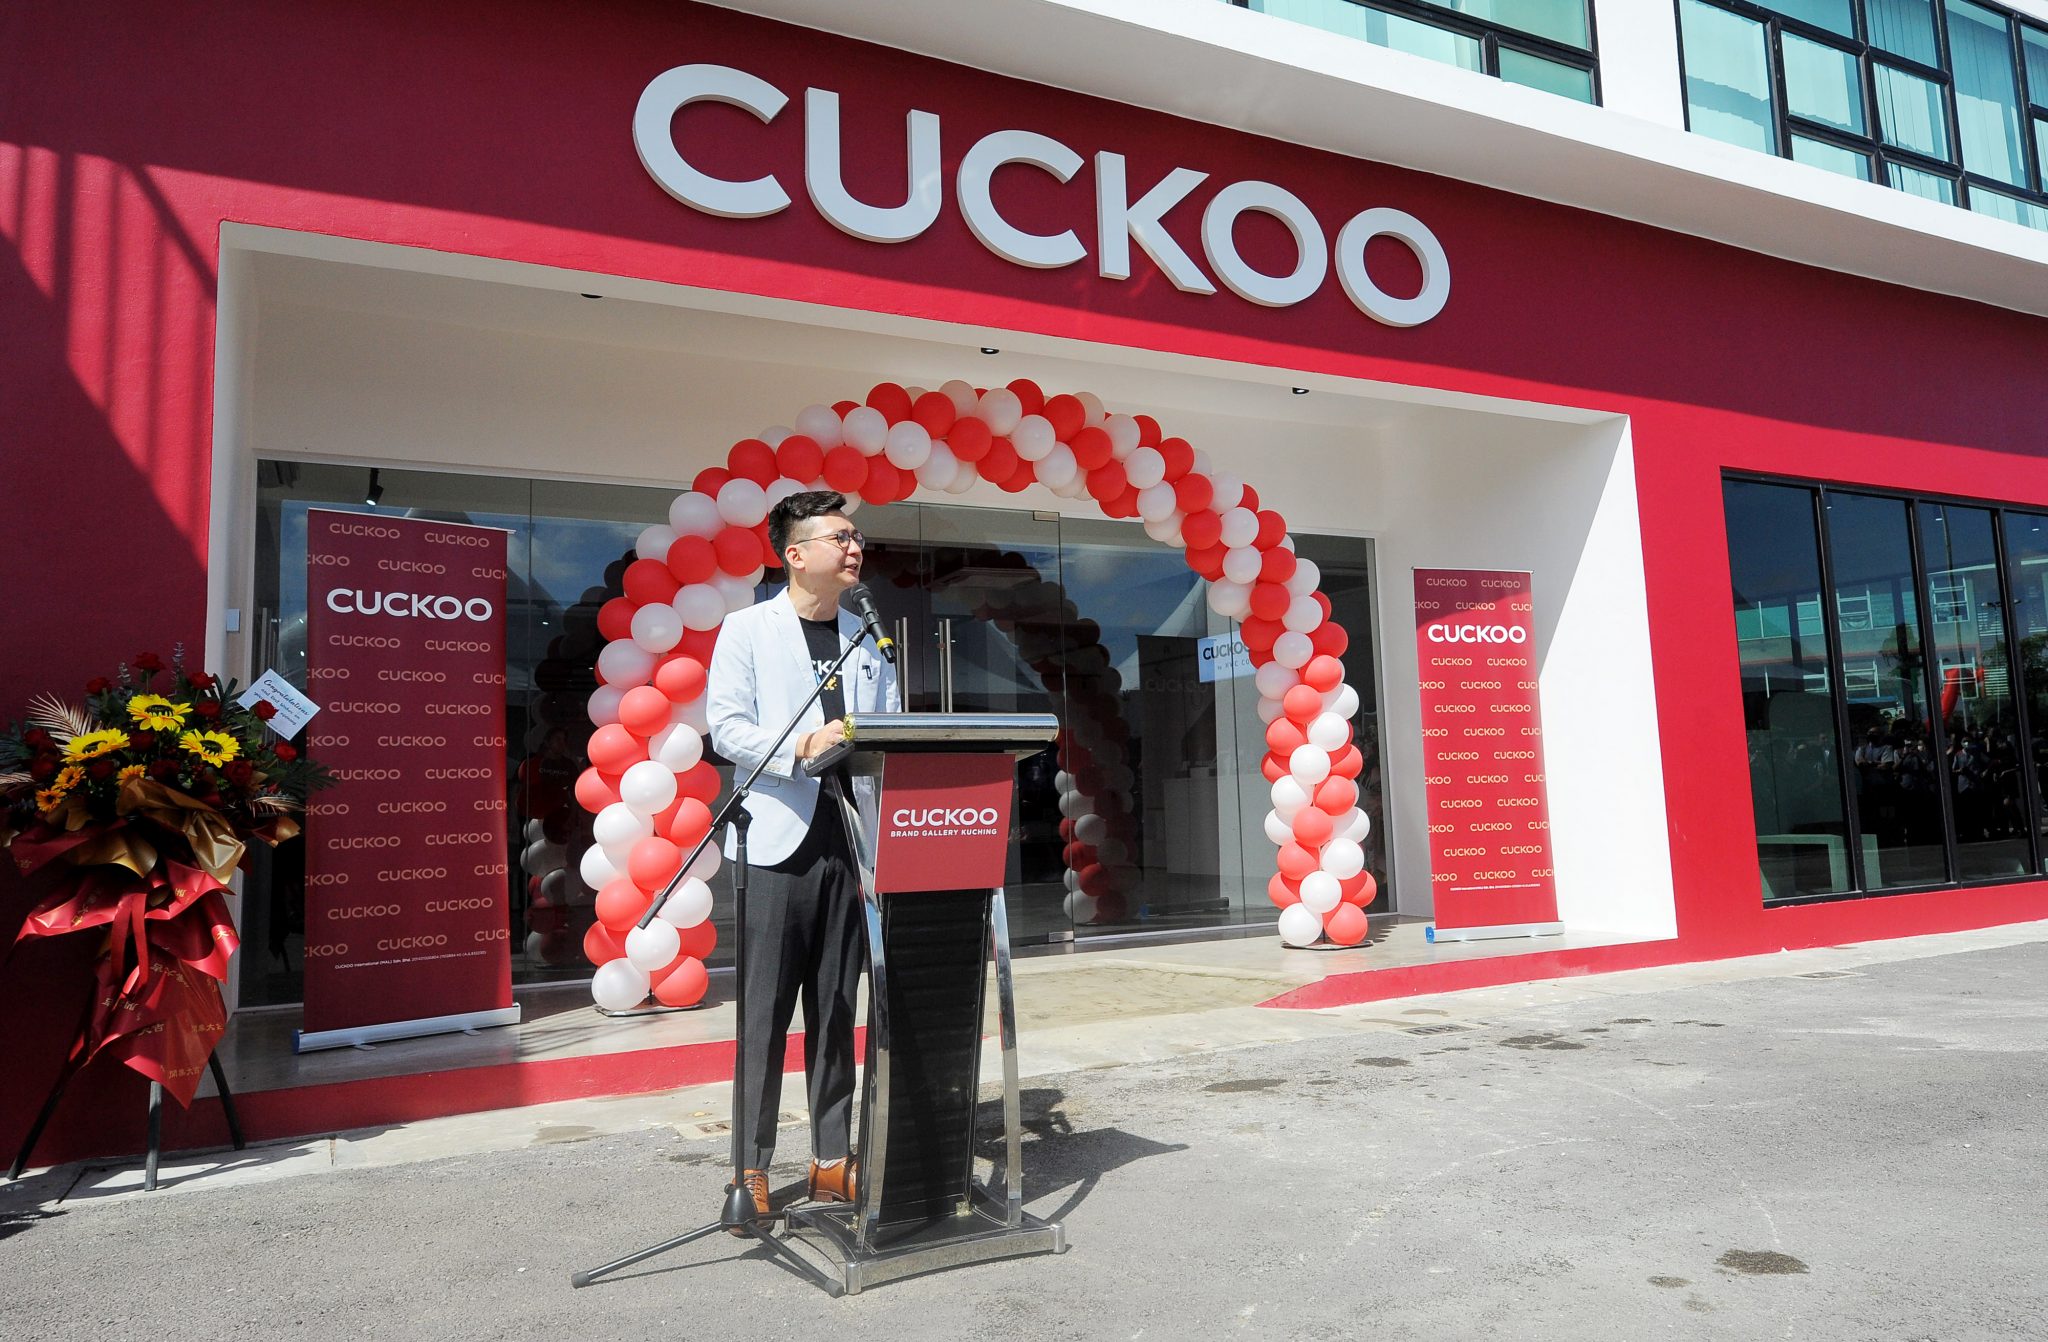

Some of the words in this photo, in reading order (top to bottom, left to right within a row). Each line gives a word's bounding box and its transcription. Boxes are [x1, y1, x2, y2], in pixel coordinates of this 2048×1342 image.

[632, 63, 1451, 328] CUCKOO
[329, 523, 401, 539] CUCKOO
[424, 532, 490, 548] CUCKOO
[377, 560, 446, 575] CUCKOO
[1426, 578, 1467, 587] CUCKOO
[1481, 580, 1521, 588] CUCKOO
[327, 588, 492, 621] CUCKOO
[1455, 602, 1495, 610] CUCKOO
[1428, 624, 1526, 643] CUCKOO
[329, 635, 401, 649] CUCKOO
[424, 640, 491, 653] CUCKOO
[1431, 657, 1472, 666] CUCKOO
[1487, 658, 1527, 666] CUCKOO
[377, 670, 446, 683] CUCKOO
[1461, 681, 1502, 689] CUCKOO
[329, 701, 401, 714] CUCKOO
[424, 704, 492, 715] CUCKOO
[1434, 705, 1476, 713] CUCKOO
[1490, 704, 1531, 712] CUCKOO
[1464, 728, 1505, 736] CUCKOO
[377, 736, 446, 747] CUCKOO
[1437, 752, 1479, 761] CUCKOO
[1494, 751, 1535, 759] CUCKOO
[425, 768, 492, 779] CUCKOO
[1467, 775, 1508, 783] CUCKOO
[377, 801, 447, 814] CUCKOO
[1440, 800, 1482, 808] CUCKOO
[1497, 798, 1539, 807] CUCKOO
[893, 808, 998, 827] CUCKOO
[1470, 823, 1512, 832] CUCKOO
[328, 836, 401, 850] CUCKOO
[425, 832, 492, 846] CUCKOO
[1443, 848, 1486, 857] CUCKOO
[1500, 845, 1542, 855] CUCKOO
[377, 868, 447, 882] CUCKOO
[1474, 870, 1516, 880] CUCKOO
[327, 904, 401, 920] CUCKOO
[425, 898, 493, 912] CUCKOO
[377, 934, 447, 950] CUCKOO
